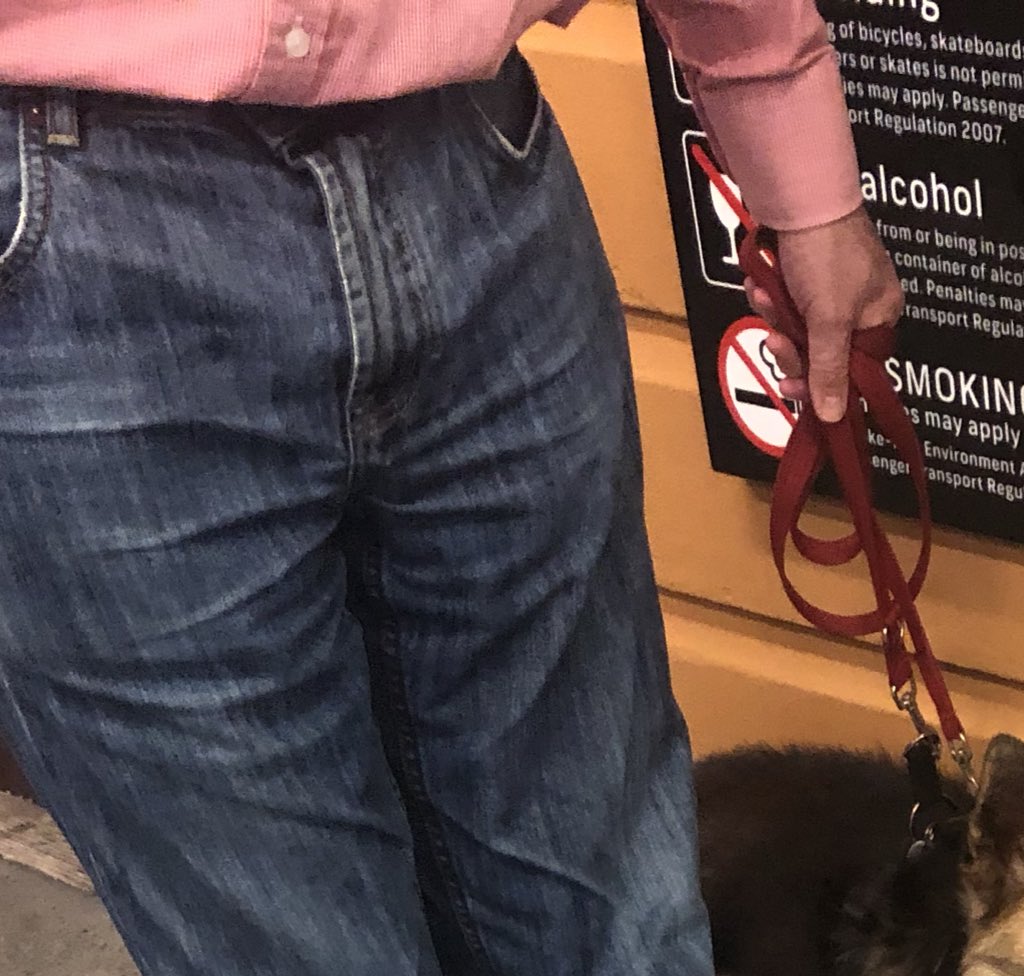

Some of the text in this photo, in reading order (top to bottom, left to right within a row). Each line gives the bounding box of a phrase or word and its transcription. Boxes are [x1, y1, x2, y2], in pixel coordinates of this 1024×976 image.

[839, 20, 855, 39] of
[858, 21, 927, 50] bicycles,
[860, 54, 875, 70] or
[880, 52, 929, 78] skates
[933, 59, 947, 80] is
[951, 62, 977, 83] not
[843, 77, 864, 97] ies
[868, 83, 899, 105] may
[903, 88, 948, 111] apply.
[848, 107, 1007, 145] ort Regulation 2007.
[861, 163, 983, 219] alcohol
[876, 218, 912, 241] from
[915, 228, 931, 244] or
[935, 227, 978, 257] being
[980, 235, 995, 255] in
[895, 249, 967, 277] container
[971, 262, 986, 280] of
[926, 278, 996, 308] Penalties
[902, 303, 968, 328] ransport
[925, 411, 963, 437] may
[968, 418, 1021, 449] apply
[924, 440, 1016, 475] Environment
